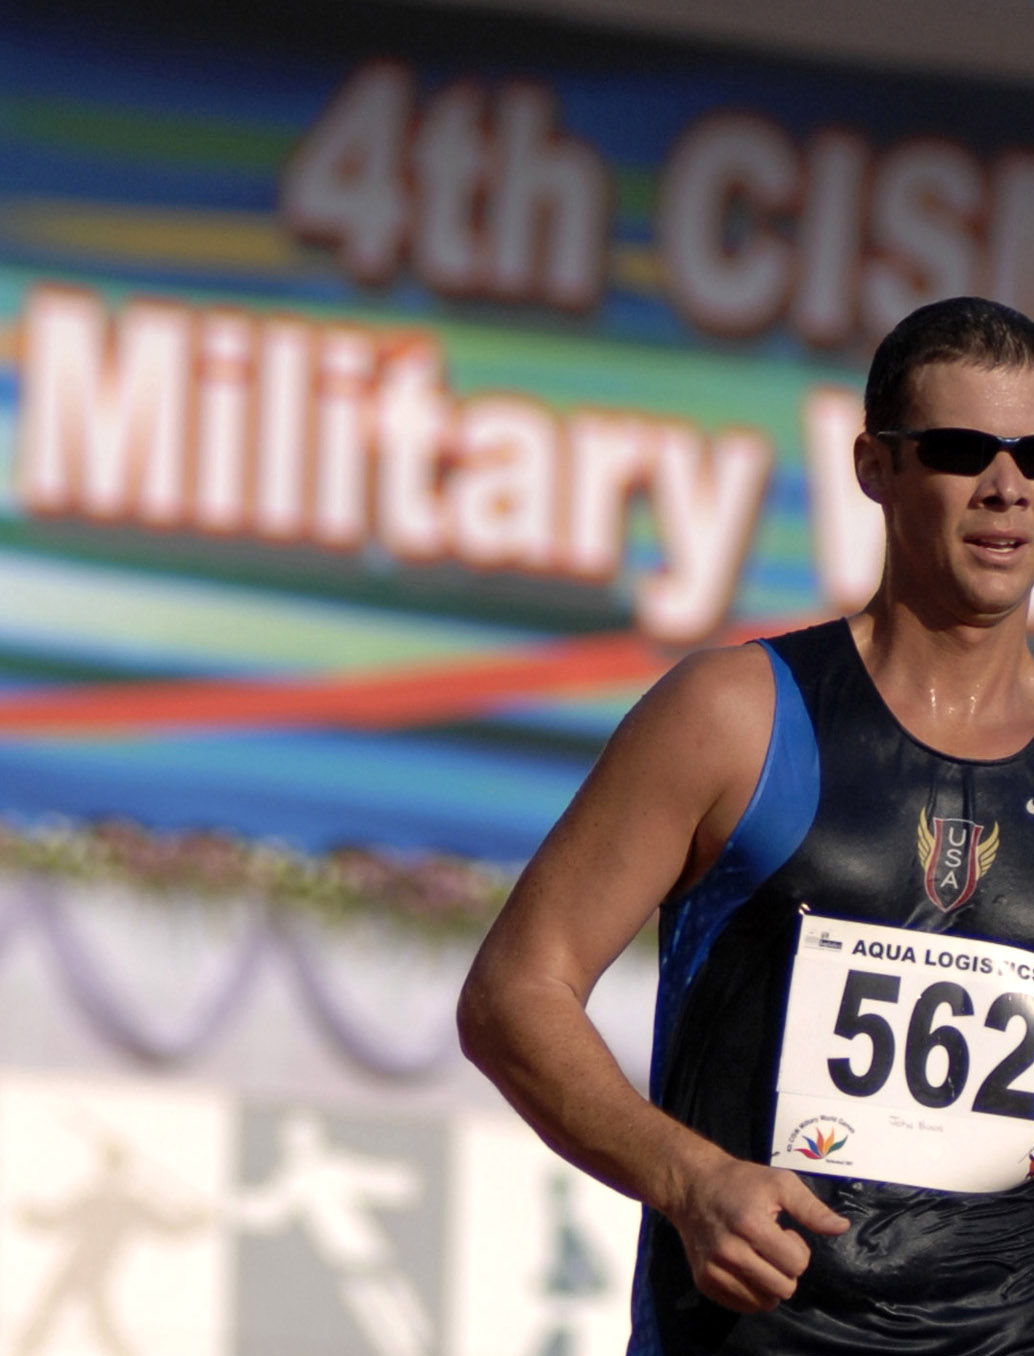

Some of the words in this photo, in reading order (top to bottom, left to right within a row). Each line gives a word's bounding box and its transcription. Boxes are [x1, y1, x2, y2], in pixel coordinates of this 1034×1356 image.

[283, 60, 612, 309] 4th
[19, 283, 770, 642] Military
[939, 826, 967, 890] USA
[852, 939, 916, 963] AQUA
